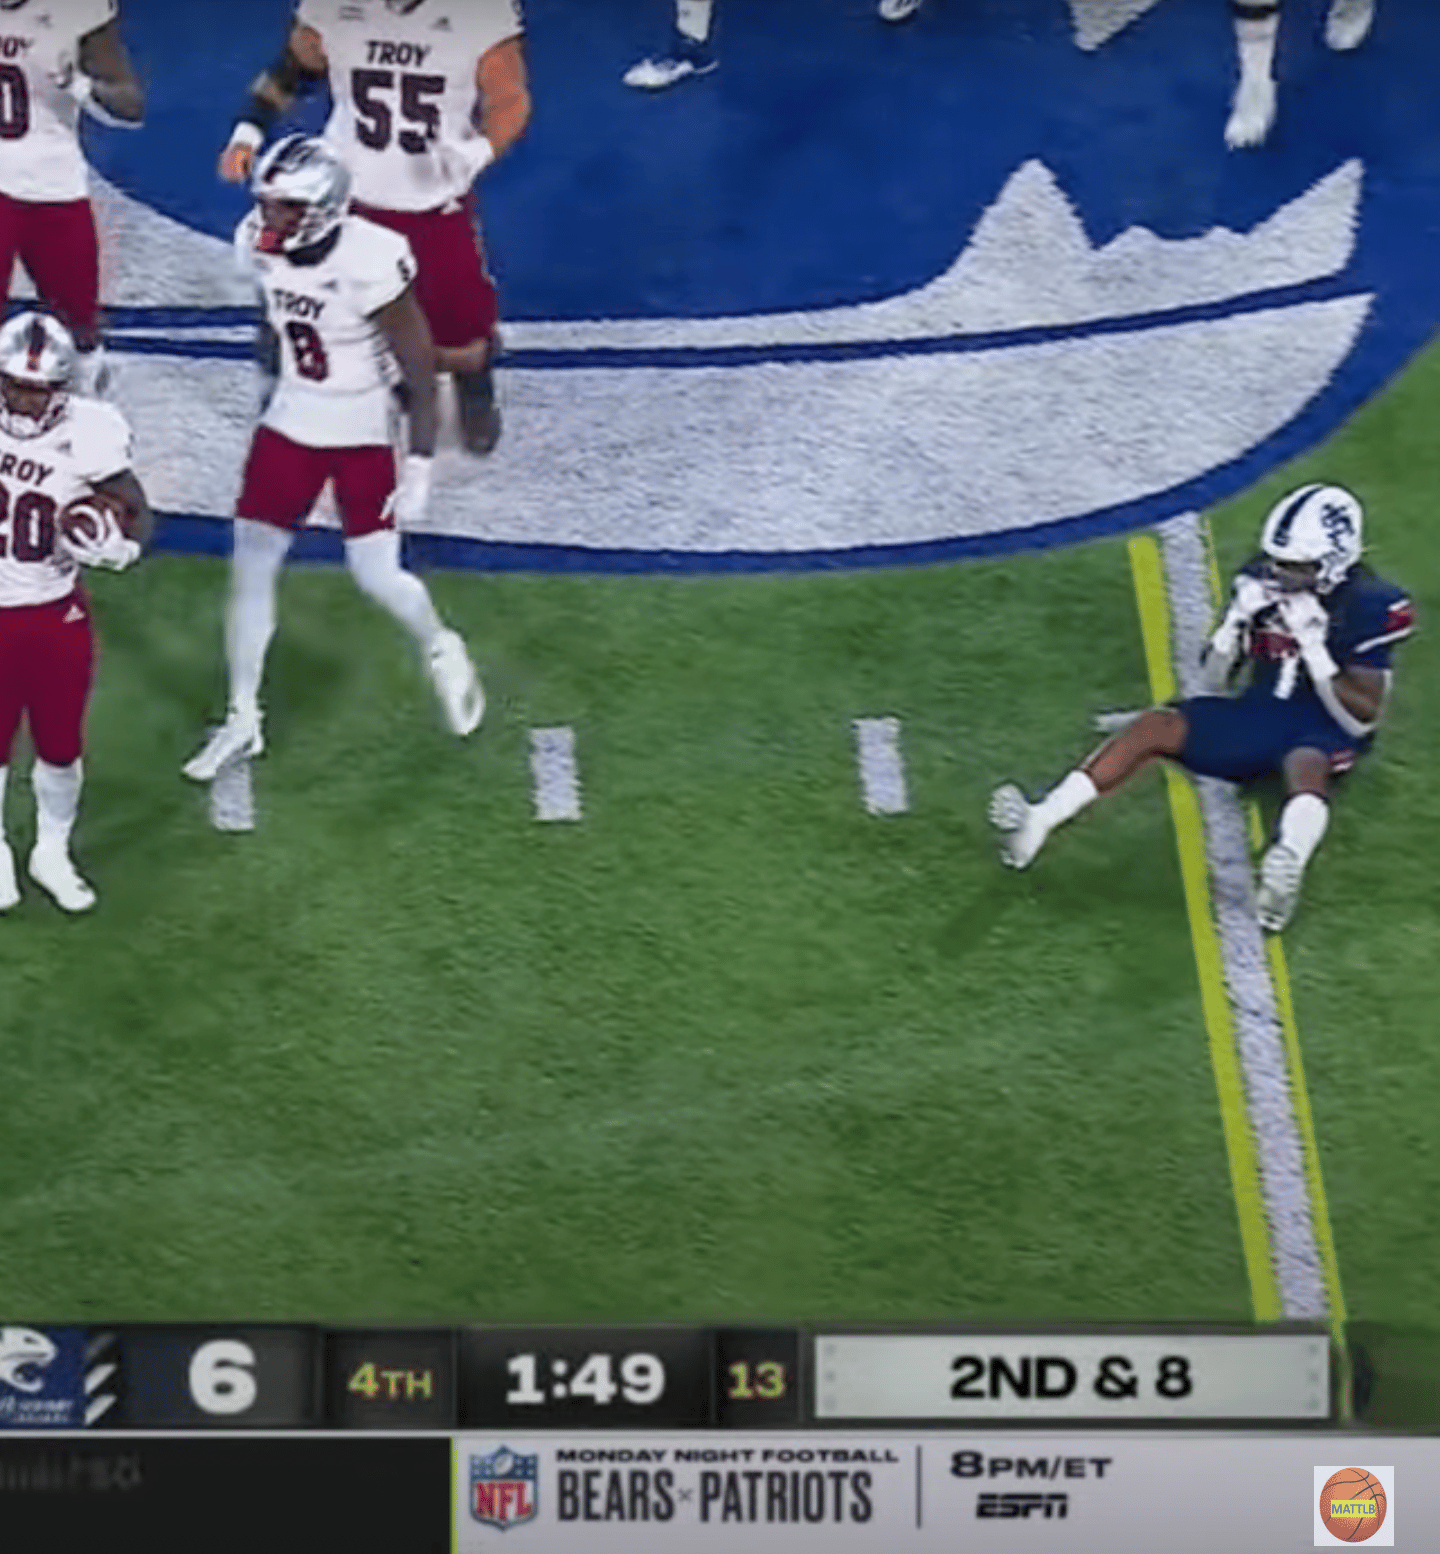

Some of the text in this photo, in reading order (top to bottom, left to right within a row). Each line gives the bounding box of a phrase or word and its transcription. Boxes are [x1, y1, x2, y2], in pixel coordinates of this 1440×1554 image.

[365, 39, 431, 68] TROY
[350, 68, 447, 156] 55
[272, 287, 326, 320] TROY
[285, 320, 329, 383] 8
